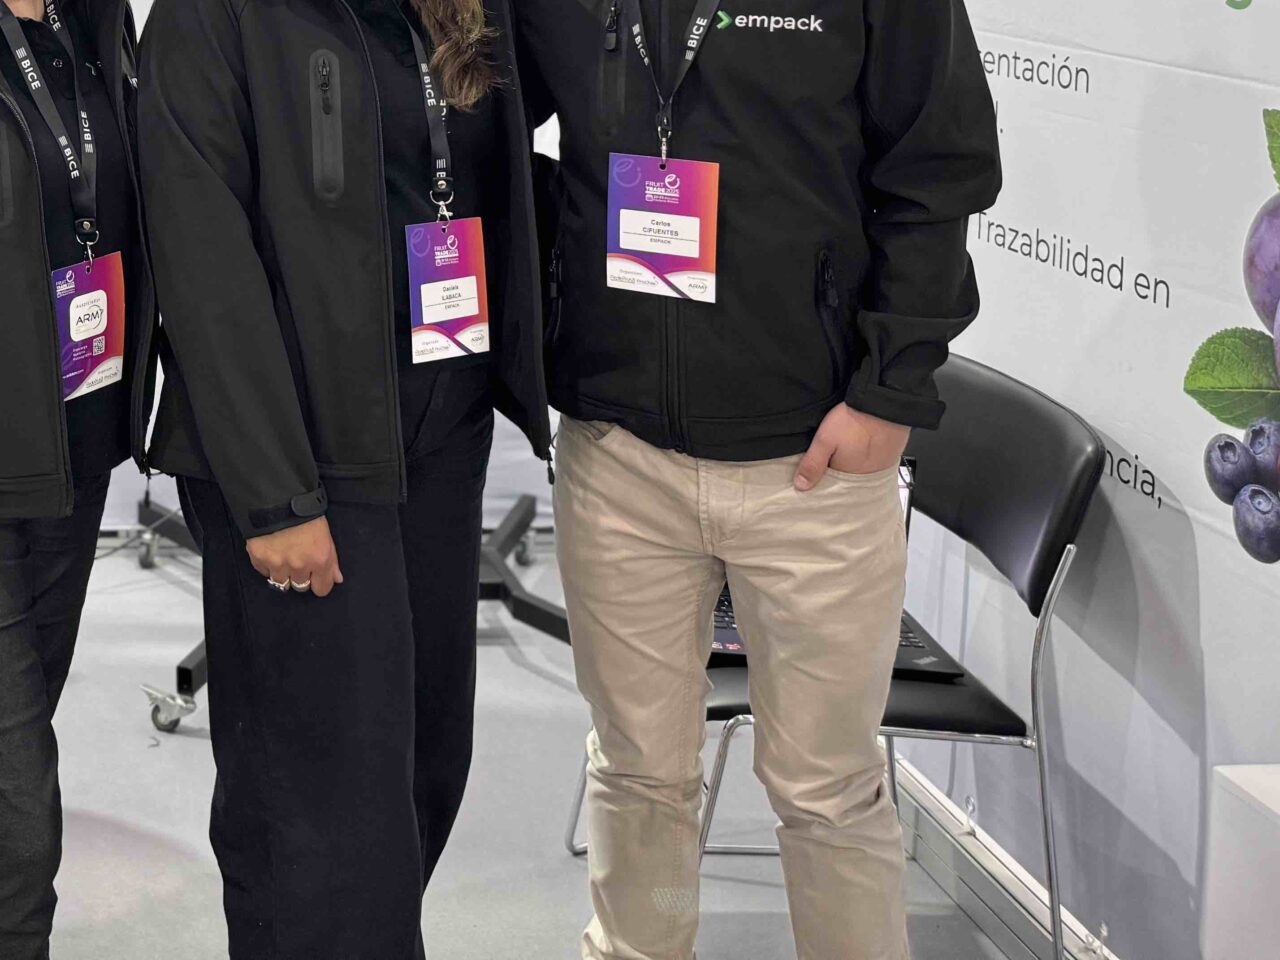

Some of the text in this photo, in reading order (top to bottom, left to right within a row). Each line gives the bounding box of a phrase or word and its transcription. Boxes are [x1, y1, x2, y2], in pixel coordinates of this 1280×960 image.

[46, 4, 61, 32] BICE
[687, 16, 707, 48] BICE
[734, 12, 823, 33] empack
[21, 59, 41, 90] BICE
[980, 50, 1090, 93] entación
[424, 76, 436, 107] BICE
[80, 110, 92, 141] BICE
[63, 147, 79, 179] BICE
[642, 227, 679, 237] CIFUENTES
[651, 219, 671, 227] Carlos
[976, 212, 1170, 309] Trazabilidad en
